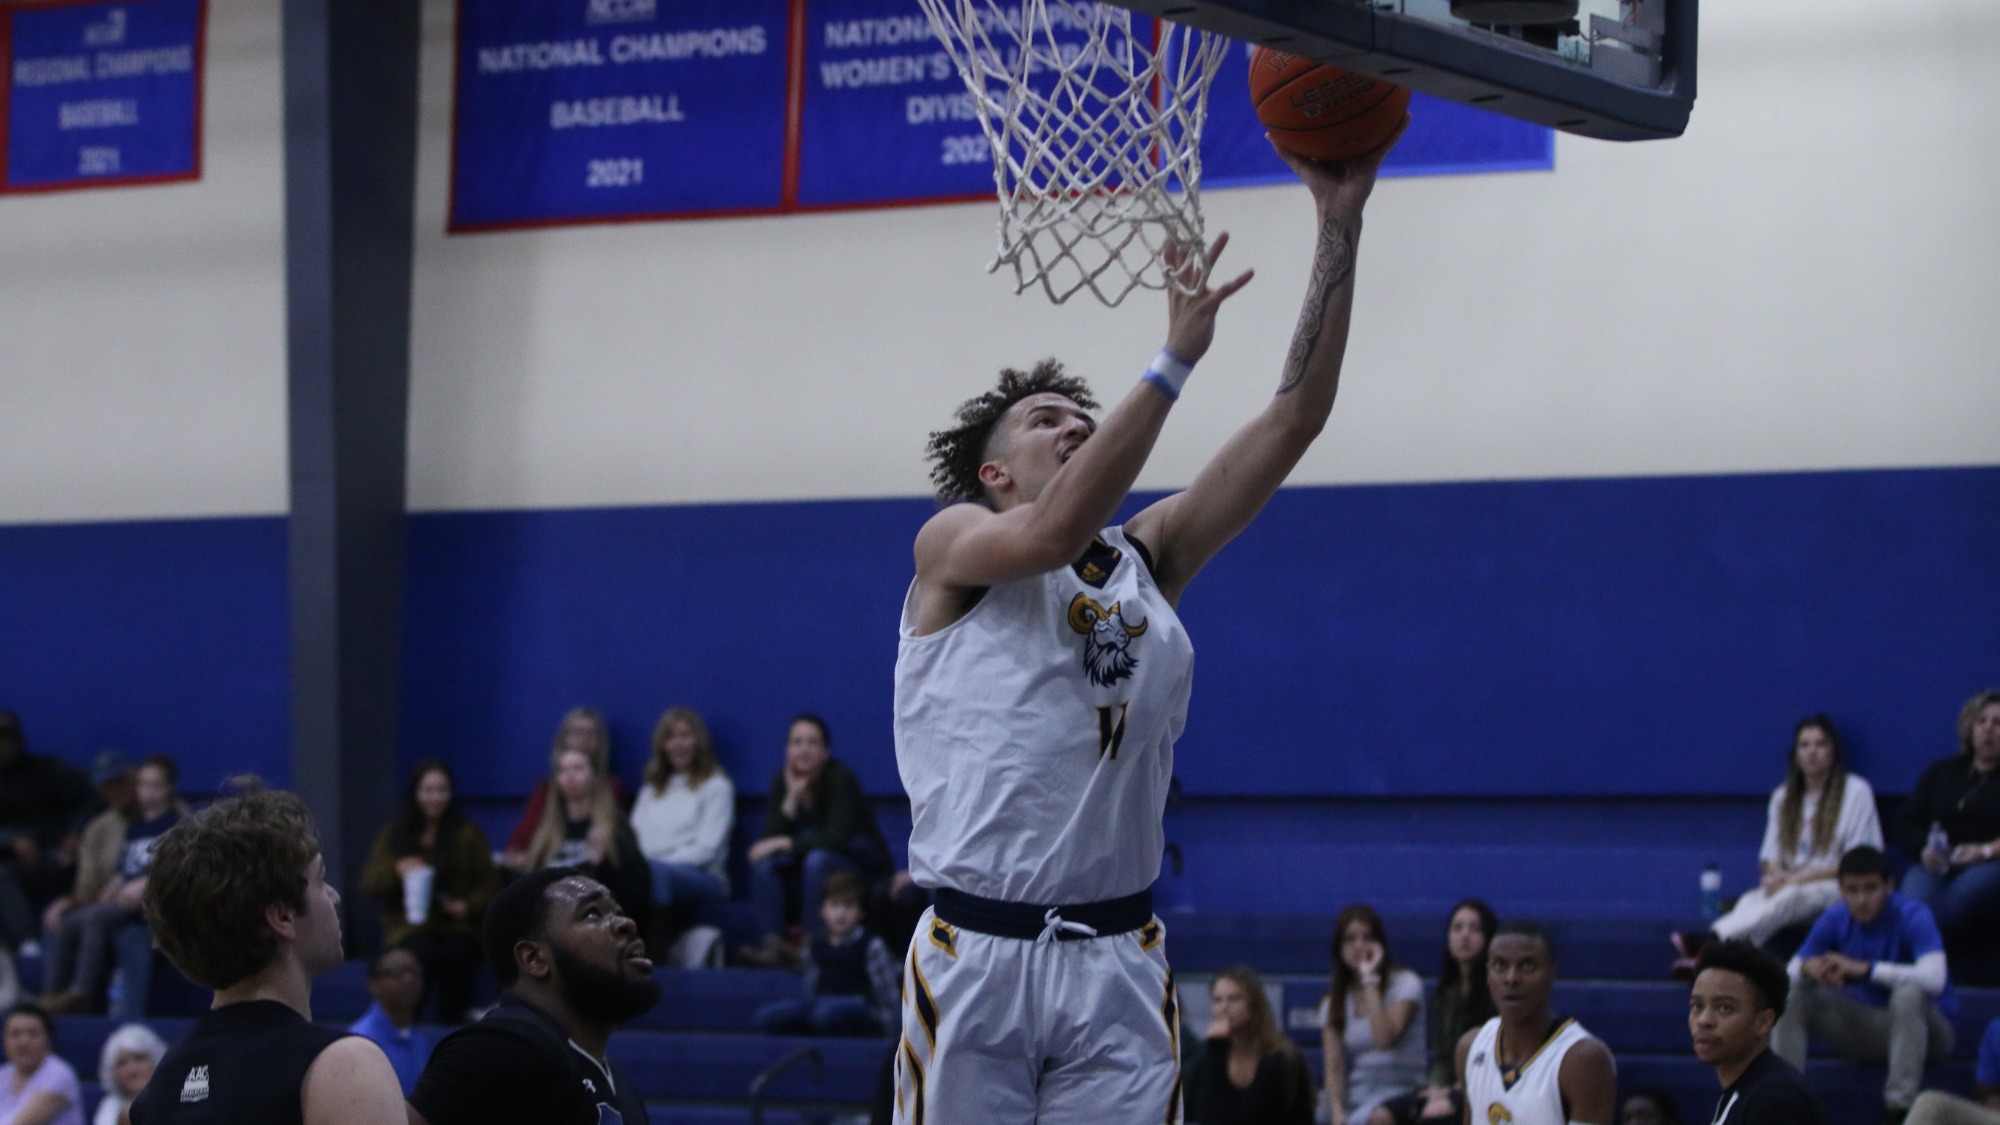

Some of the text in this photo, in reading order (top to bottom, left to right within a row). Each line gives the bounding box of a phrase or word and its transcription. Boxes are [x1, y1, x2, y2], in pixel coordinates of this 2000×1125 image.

[478, 26, 767, 73] NATIONAL CHAMPIONS
[820, 52, 951, 89] WOMEN'S
[551, 94, 685, 129] BASEBALL
[906, 91, 1023, 124] DIVISO
[941, 134, 994, 165] 202
[586, 158, 644, 188] 2021
